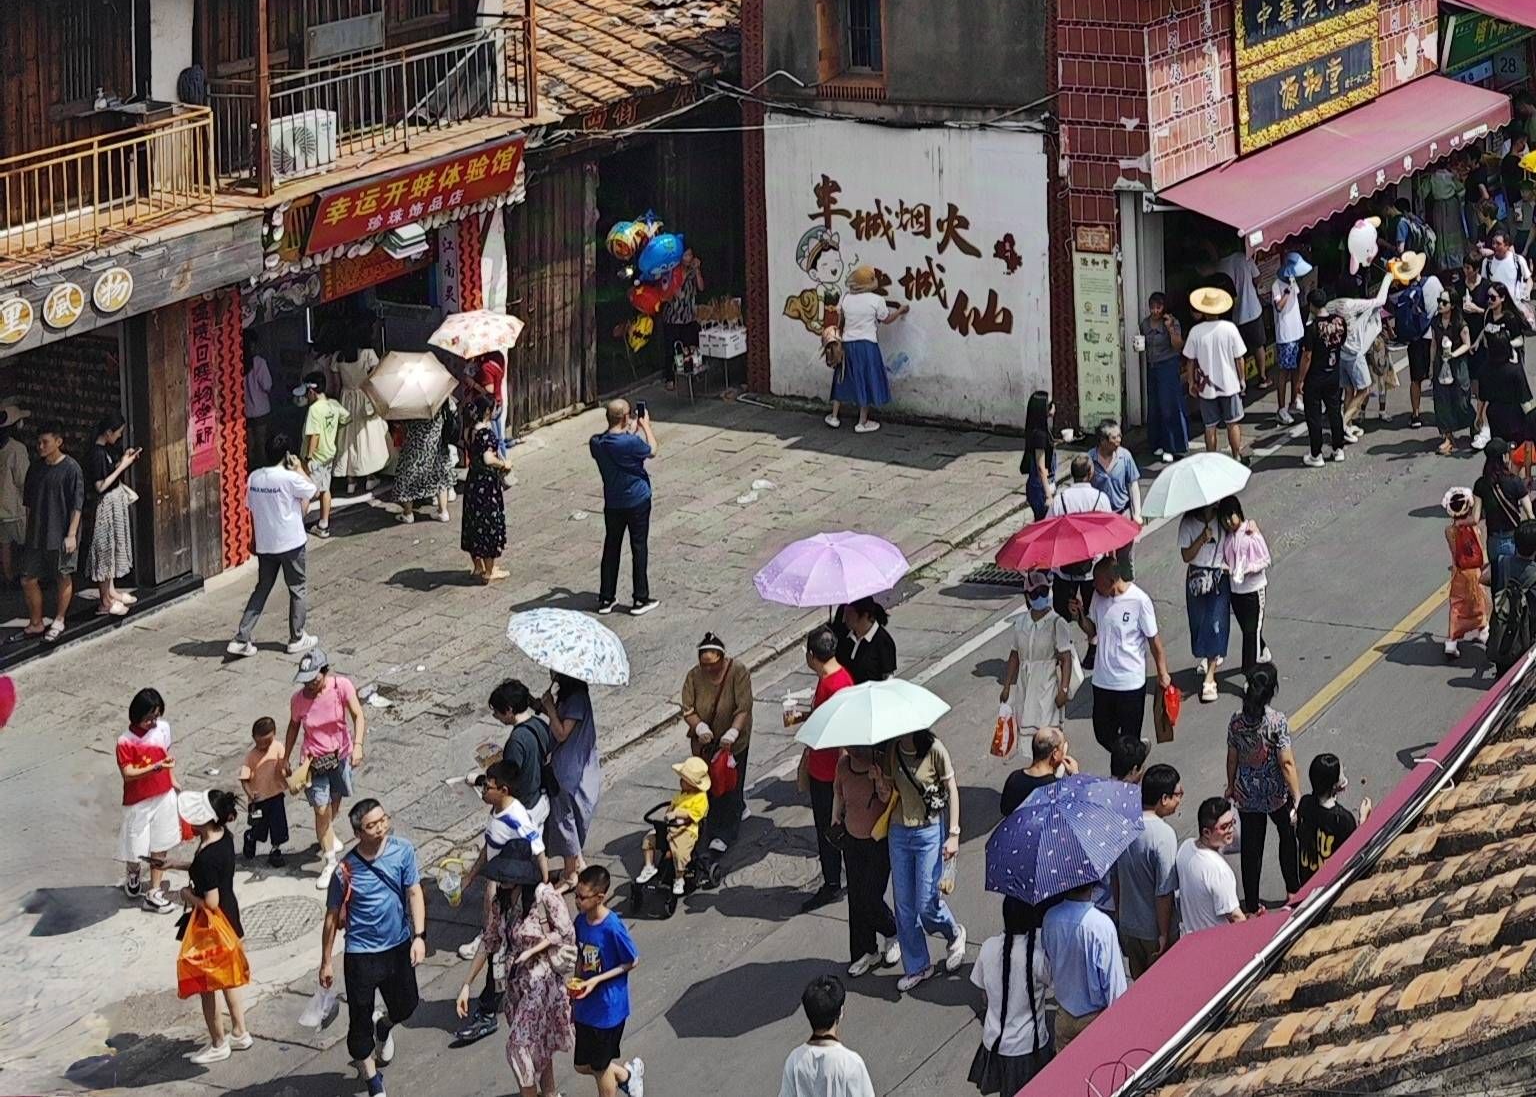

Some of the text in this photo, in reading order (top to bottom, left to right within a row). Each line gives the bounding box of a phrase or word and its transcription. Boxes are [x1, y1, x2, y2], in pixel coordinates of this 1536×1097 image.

[1279, 56, 1344, 111] 源和堂
[1499, 57, 1517, 74] 28
[322, 146, 517, 225] 幸运开蚌体验馆
[365, 188, 465, 232] 珍珠饰品店
[808, 173, 983, 259] 半城烟火
[1122, 611, 1131, 623] G
